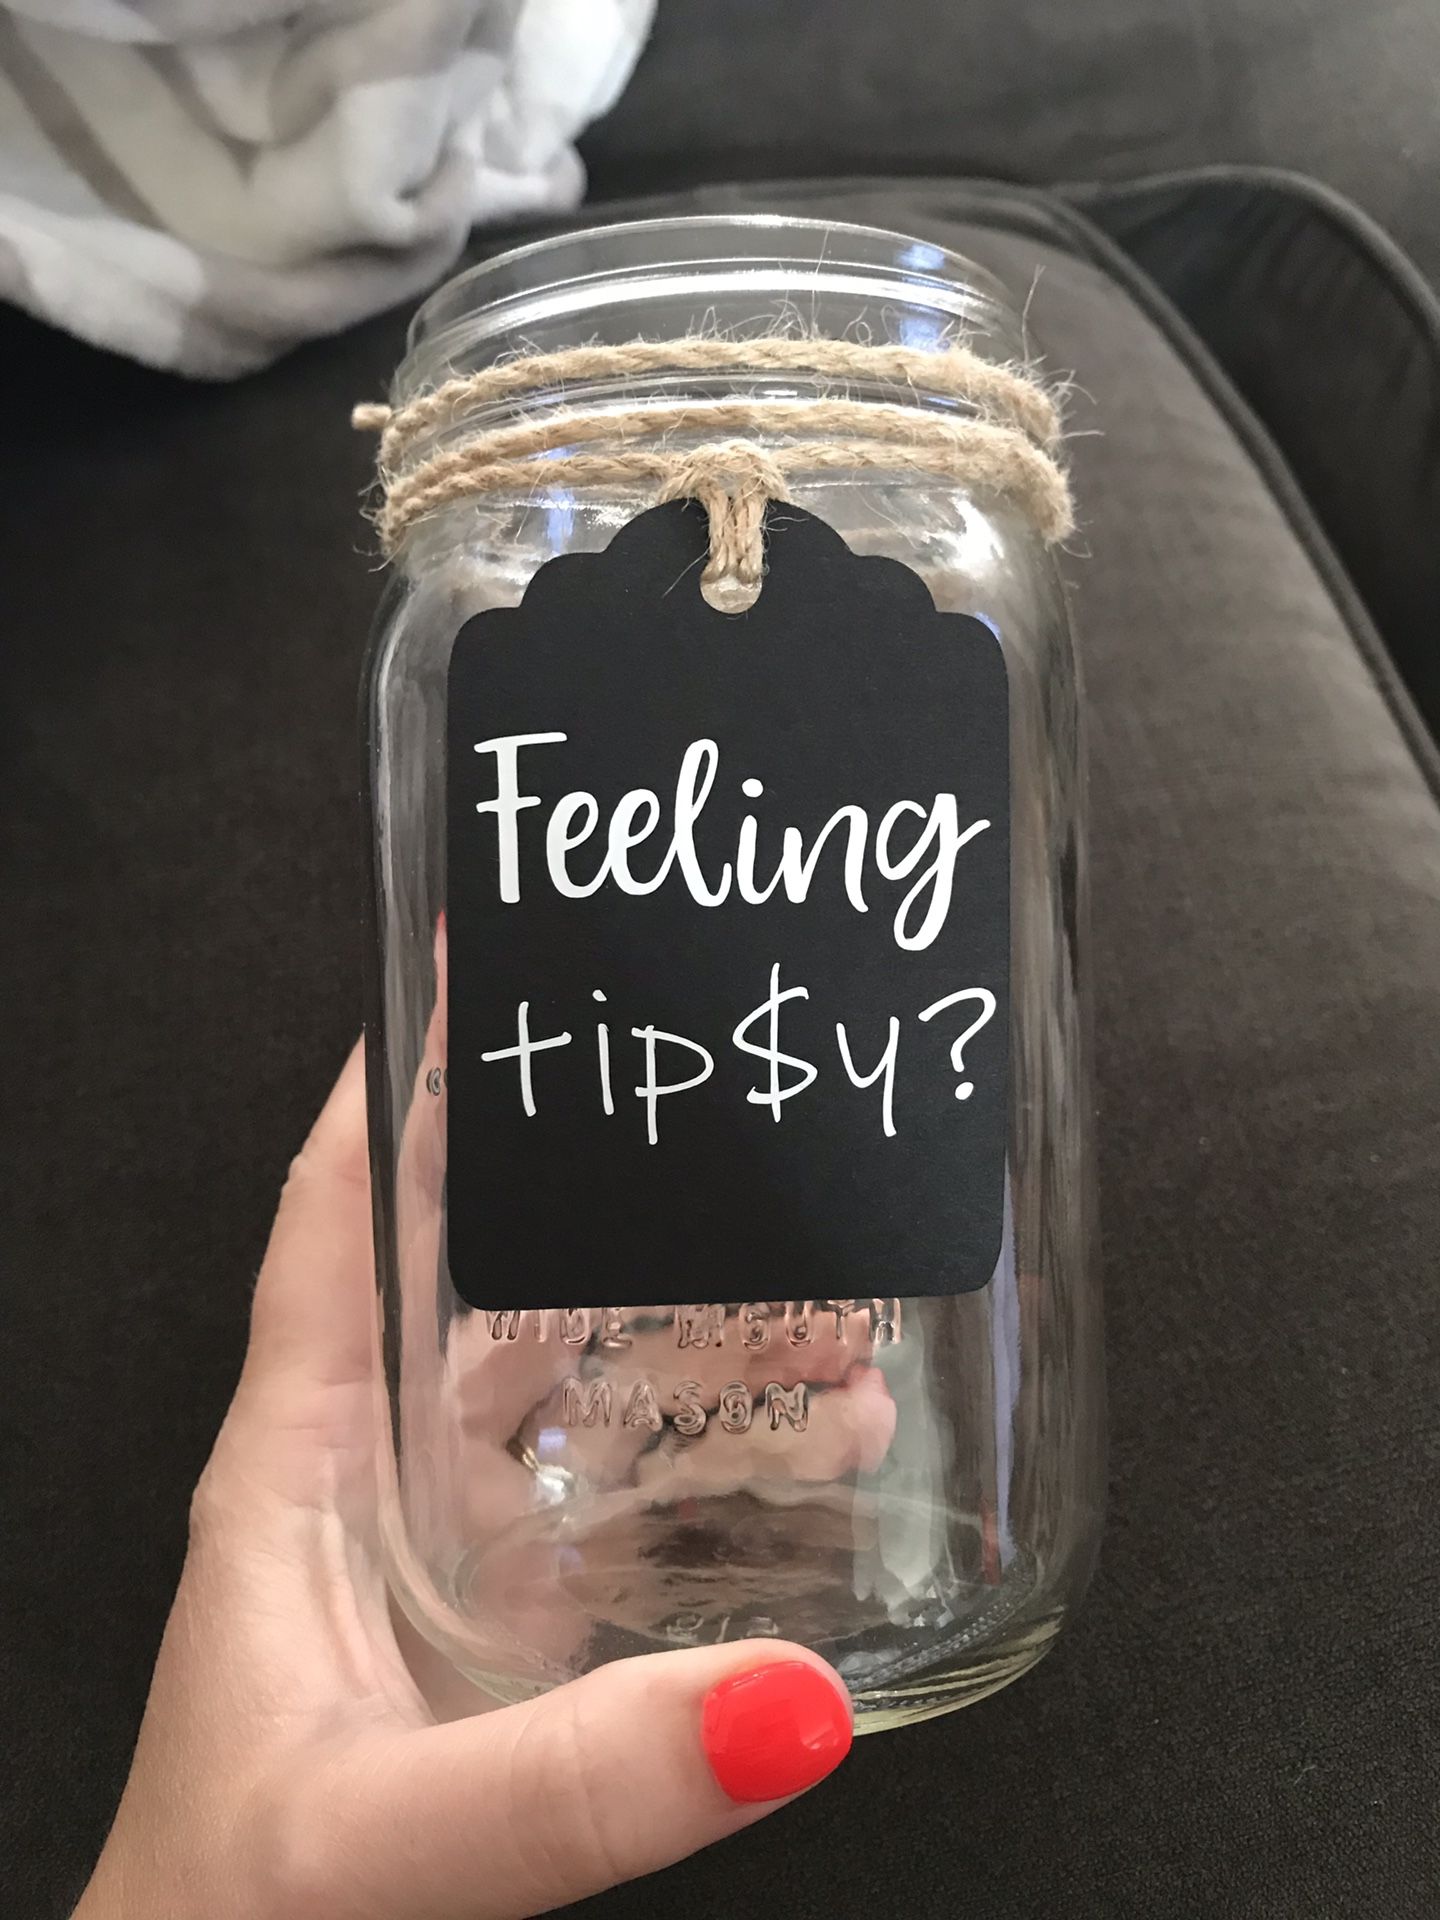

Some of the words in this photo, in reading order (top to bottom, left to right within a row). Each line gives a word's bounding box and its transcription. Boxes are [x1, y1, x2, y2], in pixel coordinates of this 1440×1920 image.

[473, 731, 991, 952] Feeling
[480, 962, 997, 1146] tip$y?
[674, 1299, 902, 1351] MOUTH
[562, 1375, 811, 1436] MASON
